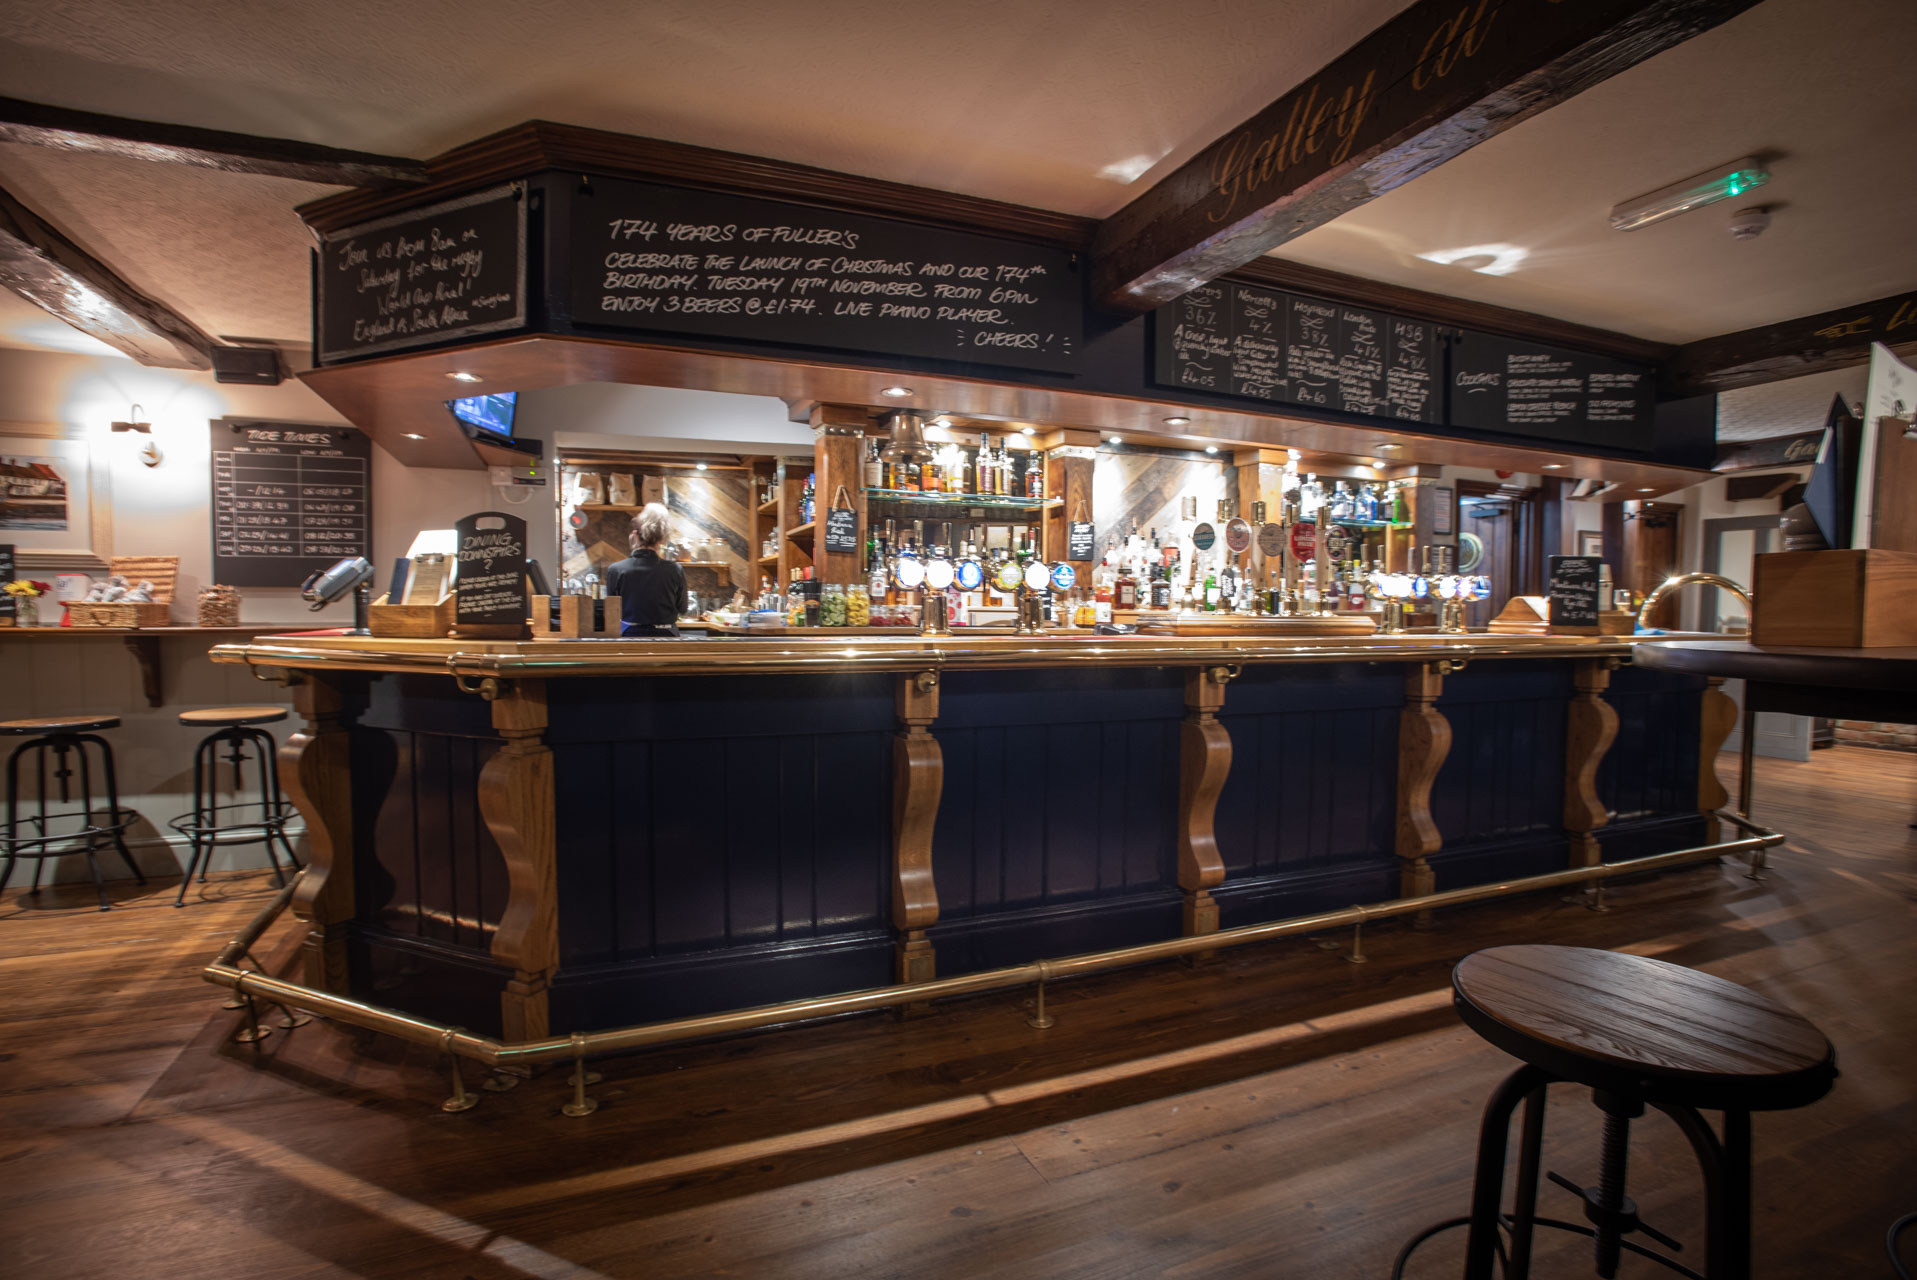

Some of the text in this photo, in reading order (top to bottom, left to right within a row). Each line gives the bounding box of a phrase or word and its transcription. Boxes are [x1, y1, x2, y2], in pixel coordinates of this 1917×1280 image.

[1208, 69, 1378, 222] Galley
[609, 219, 858, 249] 174 YEARS OF FULLER'S
[605, 253, 699, 270] CELEBRATE
[704, 254, 735, 270] THE
[739, 256, 803, 271] LAUNCH
[805, 257, 831, 271] OF
[831, 257, 914, 275] CHRISTMAS
[919, 263, 955, 277] AND
[959, 266, 989, 280] OUR
[707, 275, 785, 291] TUESDAY
[829, 279, 927, 297] NOVEMBER
[934, 284, 982, 299] FROM
[602, 296, 659, 313] ENJOY
[663, 296, 680, 312] 3
[682, 297, 742, 313] BEERS
[834, 302, 873, 316] LIVE
[879, 303, 931, 319] PIANO
[247, 430, 331, 444] TIDE TIMES
[463, 532, 512, 549] DINING
